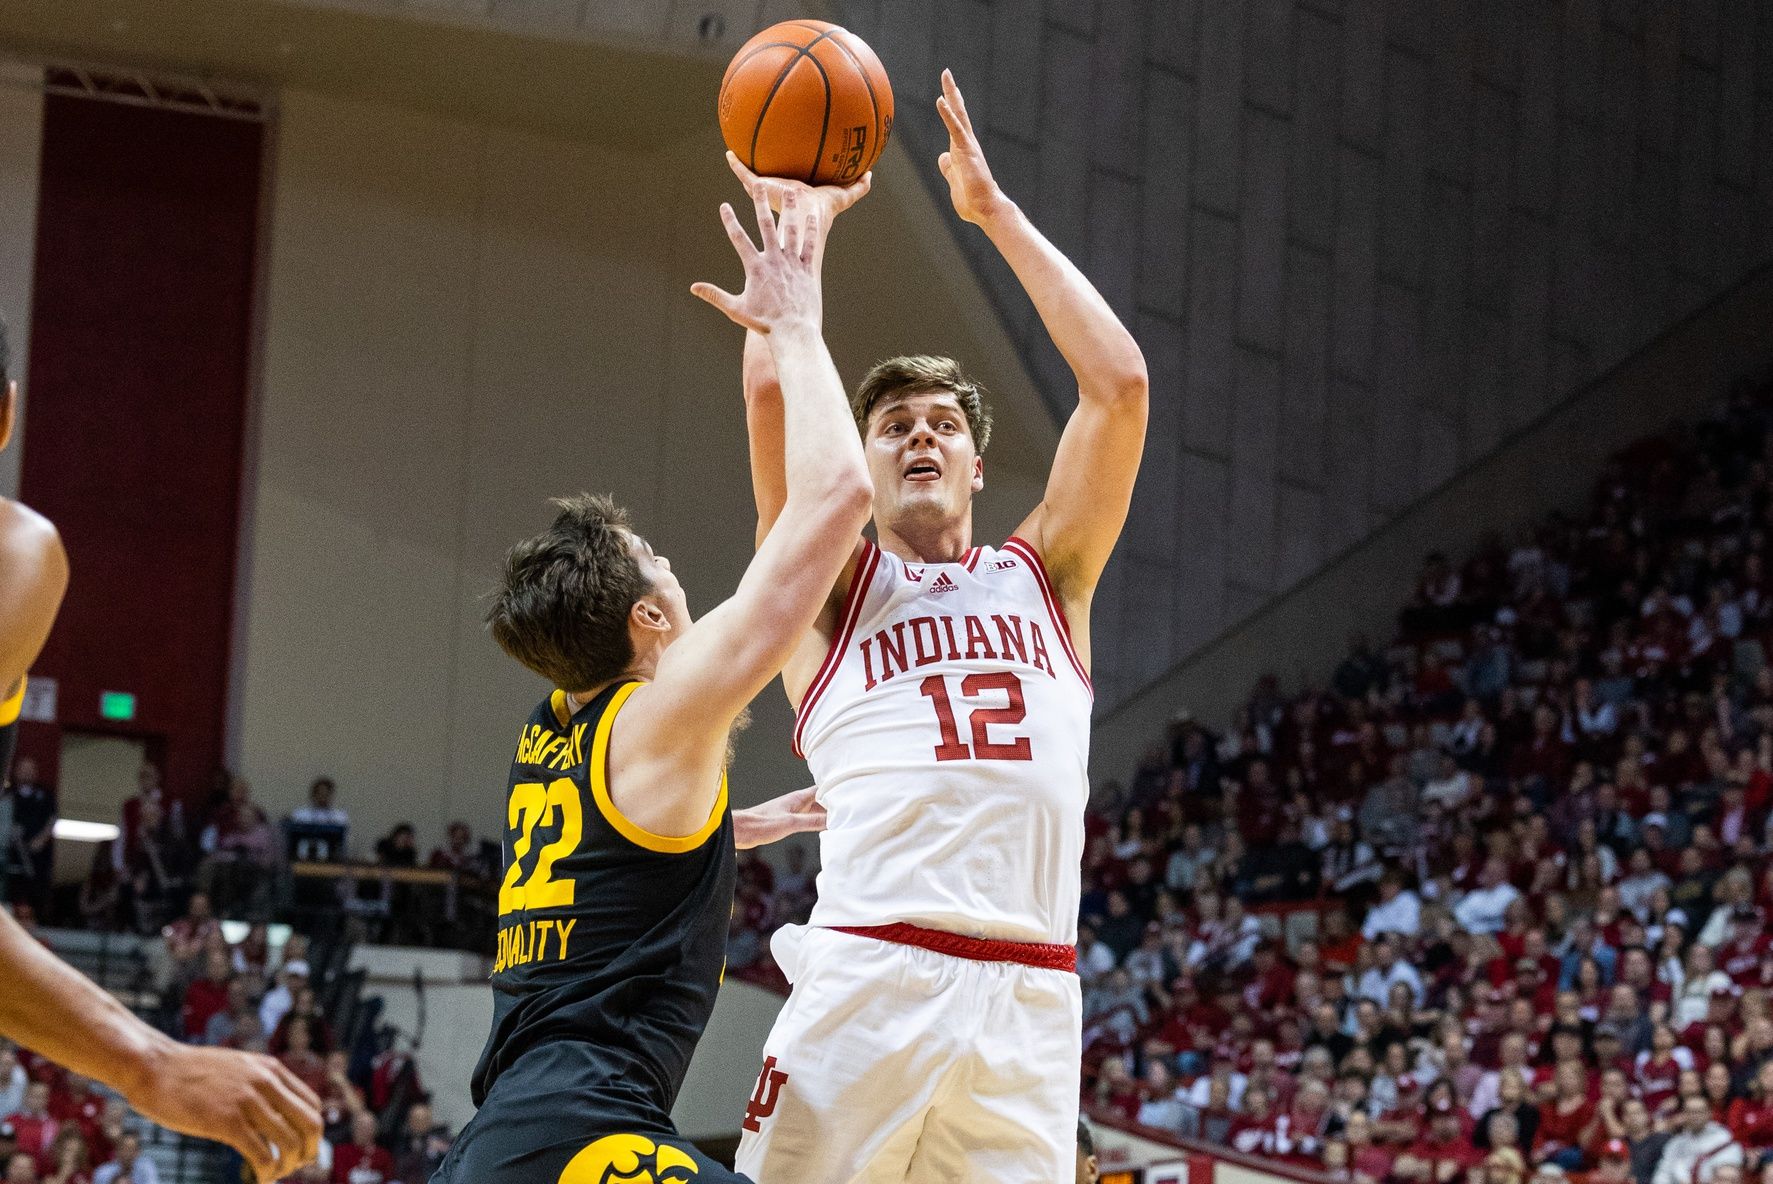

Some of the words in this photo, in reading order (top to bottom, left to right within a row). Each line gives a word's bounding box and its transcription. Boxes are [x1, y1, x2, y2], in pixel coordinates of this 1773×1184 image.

[929, 584, 959, 594] adidas
[859, 614, 1056, 692] INDIANA
[920, 671, 1032, 761] 12
[498, 777, 582, 916] 22
[492, 918, 577, 974] QUALITY
